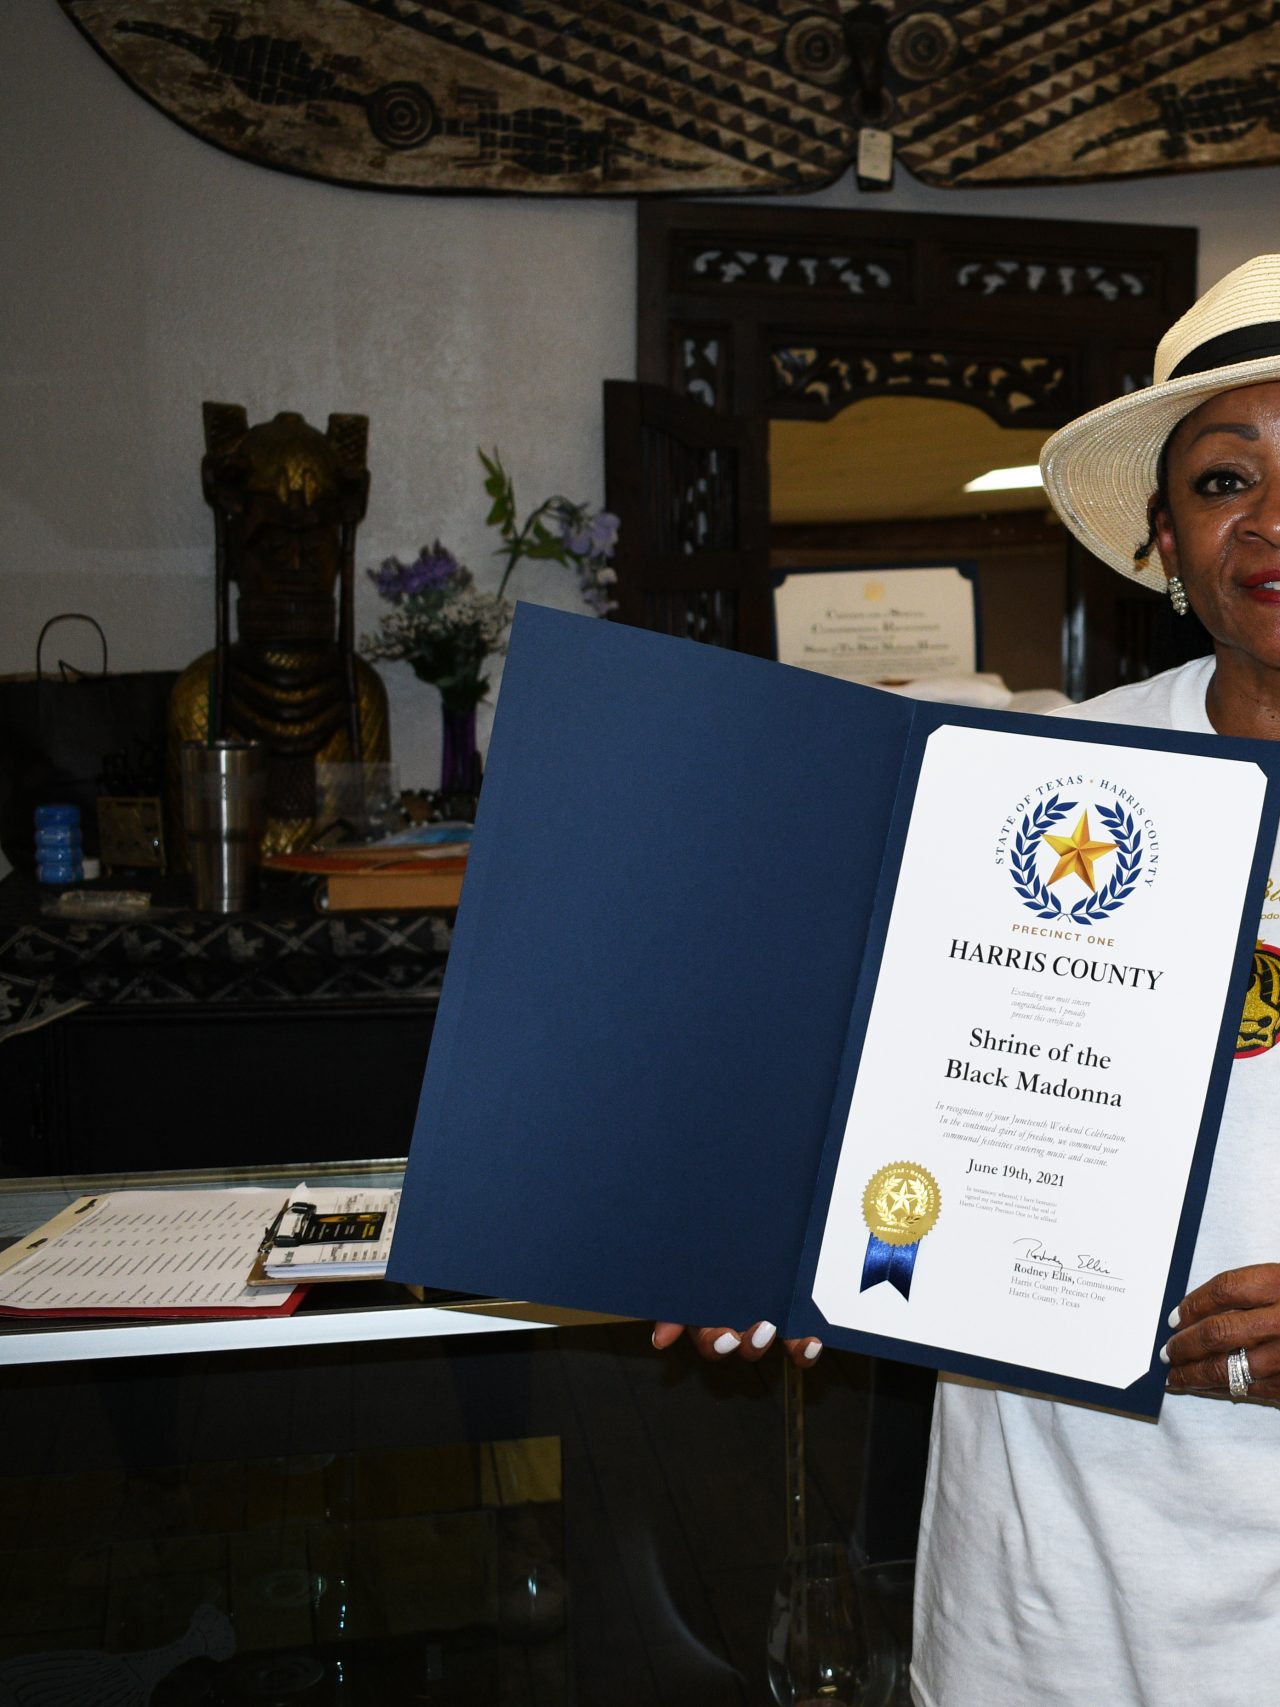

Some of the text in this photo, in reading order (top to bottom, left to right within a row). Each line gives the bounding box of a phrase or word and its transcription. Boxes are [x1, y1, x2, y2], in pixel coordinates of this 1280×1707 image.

[995, 775, 1084, 865] STATE OF TEXAS
[1100, 779, 1159, 887] HARRIS COUNTY
[1012, 924, 1115, 947] PRECINCT ONE
[948, 938, 1165, 991] HARRIS COUNTY
[1011, 987, 1043, 1002] Extending
[1056, 995, 1070, 1004] most
[1071, 998, 1091, 1007] sincere
[1009, 1011, 1032, 1021] present
[1034, 1013, 1045, 1022] this
[1046, 1016, 1074, 1027] certificate
[1064, 1008, 1086, 1019] proudly
[969, 1027, 1112, 1069] Shrine of the
[944, 1058, 1123, 1107] Black Madonna
[935, 1100, 945, 1110] In
[946, 1104, 984, 1118] recognition
[985, 1111, 994, 1122] of
[994, 1114, 1010, 1123] your
[1011, 1114, 1048, 1129] Juneteenth
[1050, 1121, 1083, 1136] Weekend
[939, 1114, 948, 1124] In
[950, 1116, 961, 1127] the
[963, 1120, 997, 1134] continued
[997, 1126, 1017, 1137] spirit
[1018, 1129, 1027, 1141] of
[1026, 1130, 1056, 1144] freedom,
[1069, 1139, 1102, 1152] commend
[1102, 1145, 1119, 1156] your
[943, 1130, 1109, 1167] communal festivities centering music and cuisine.
[966, 1158, 1065, 1187] June 19th, 2021
[959, 1200, 975, 1208] Harris
[976, 1203, 994, 1212] County
[995, 1207, 1015, 1215] Precinct
[1016, 1210, 1026, 1218] One
[1010, 1276, 1106, 1302] Harris County Precinct One
[1014, 1263, 1126, 1294] Rodney Ellis, Commissioner
[1008, 1287, 1081, 1309] Harris County, Texas
